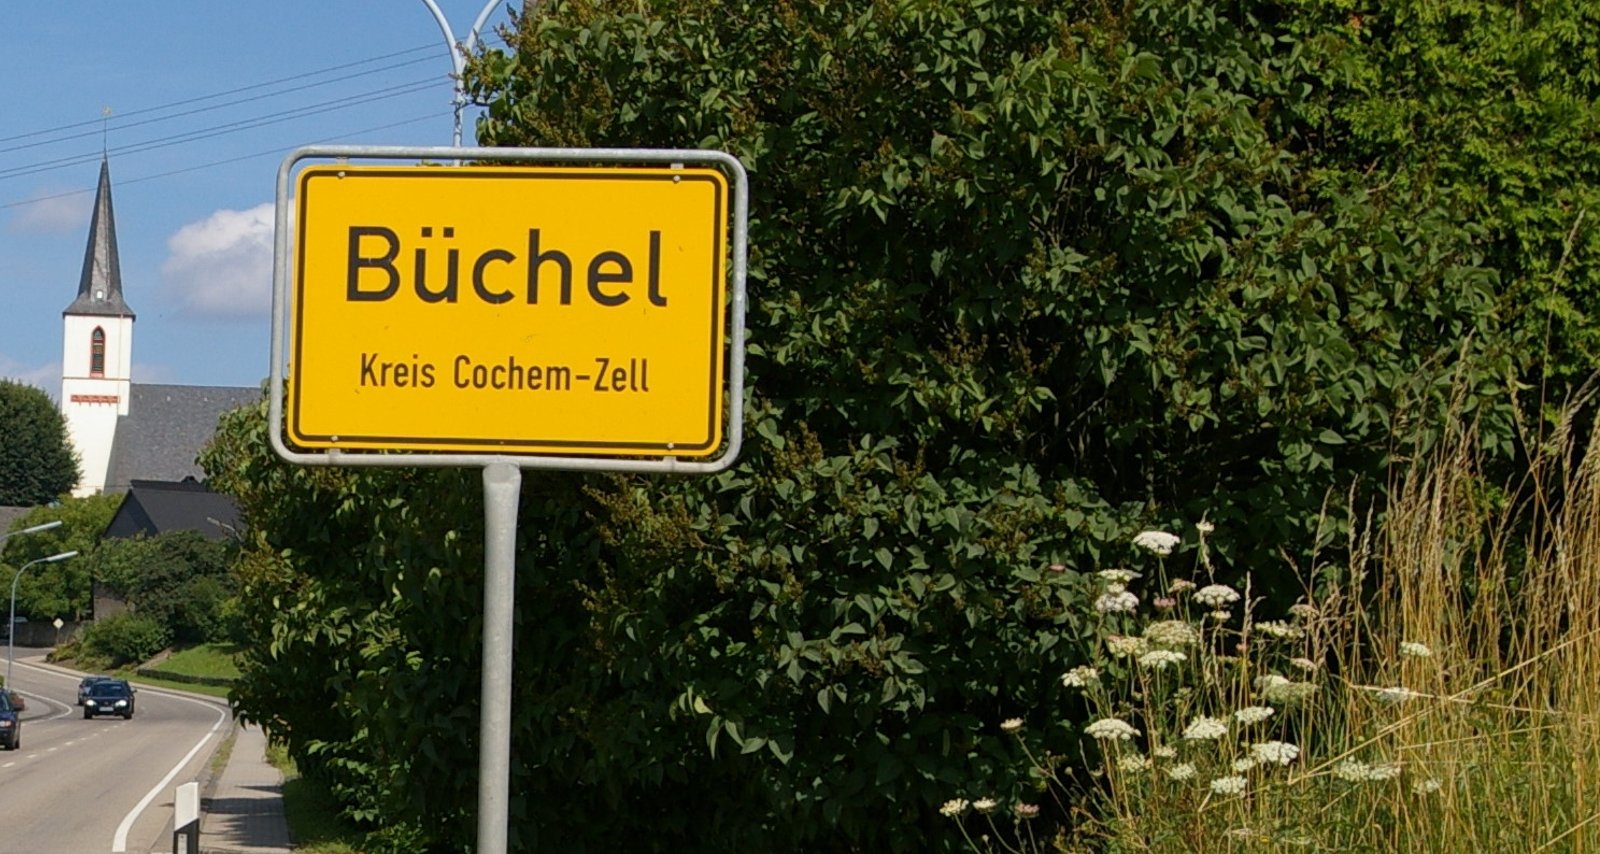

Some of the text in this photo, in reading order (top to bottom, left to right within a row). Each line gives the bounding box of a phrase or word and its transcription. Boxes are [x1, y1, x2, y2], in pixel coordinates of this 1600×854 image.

[346, 226, 667, 307] Büchel
[360, 353, 649, 392] Kreis Cochem-Zell
